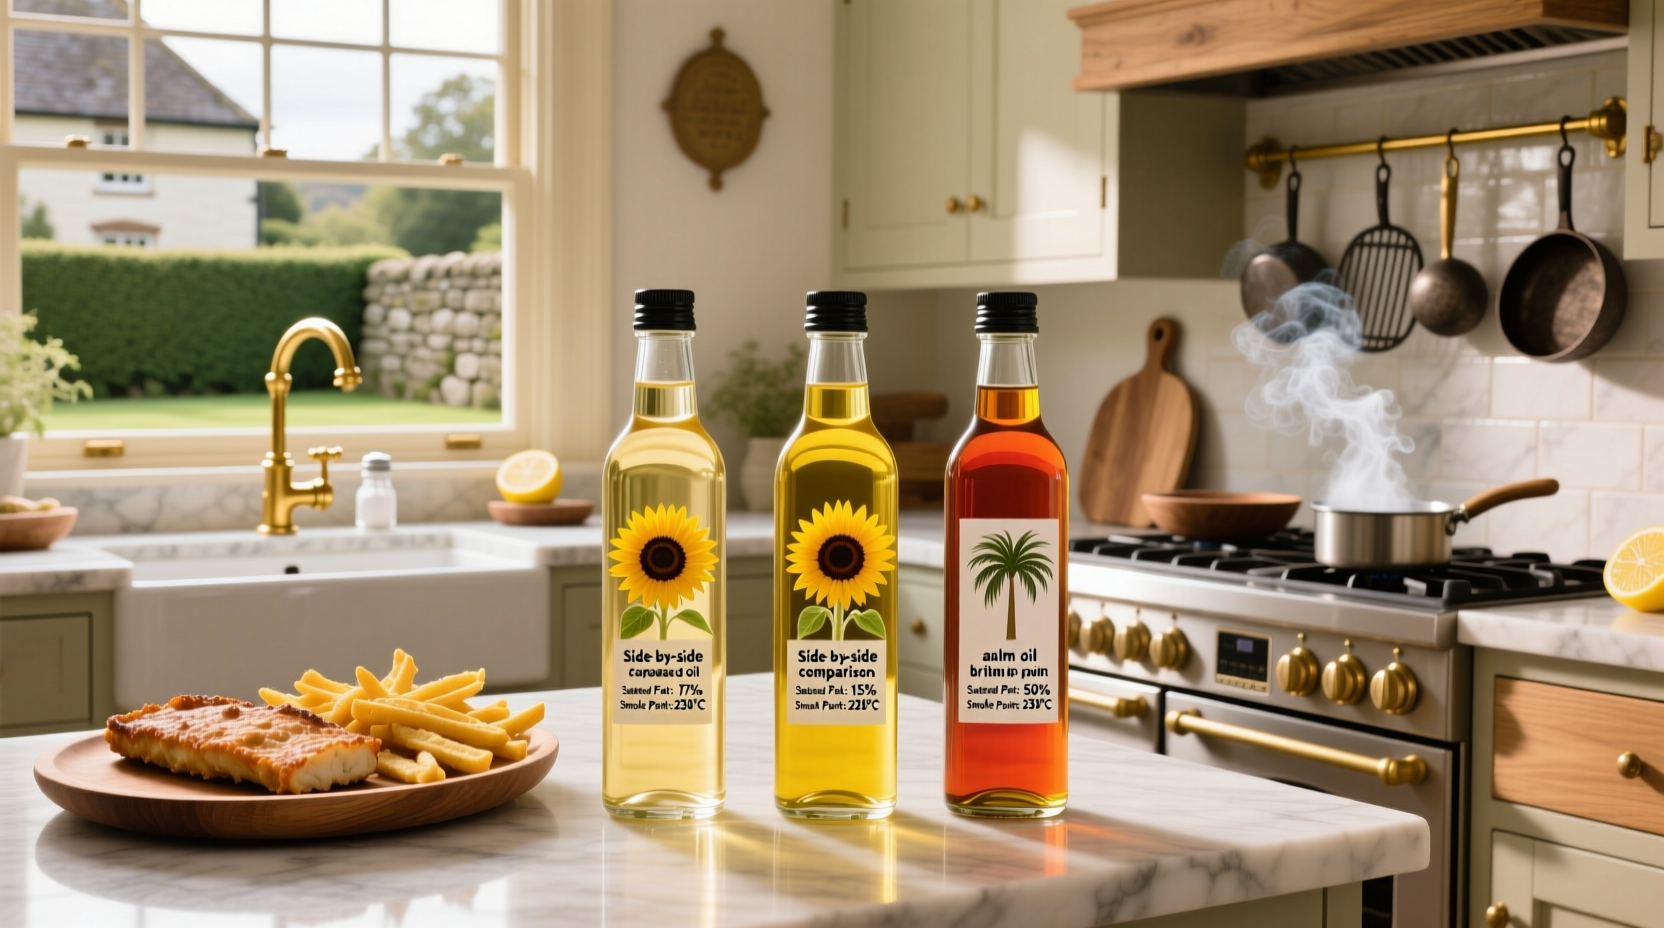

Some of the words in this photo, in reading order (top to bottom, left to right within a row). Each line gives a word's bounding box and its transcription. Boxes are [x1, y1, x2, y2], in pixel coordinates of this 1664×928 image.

[1020, 648, 1037, 662] oil
[685, 665, 700, 678] oil
[798, 665, 876, 682] comparison
[851, 683, 877, 696] 15%
[1023, 683, 1051, 696] 50%
